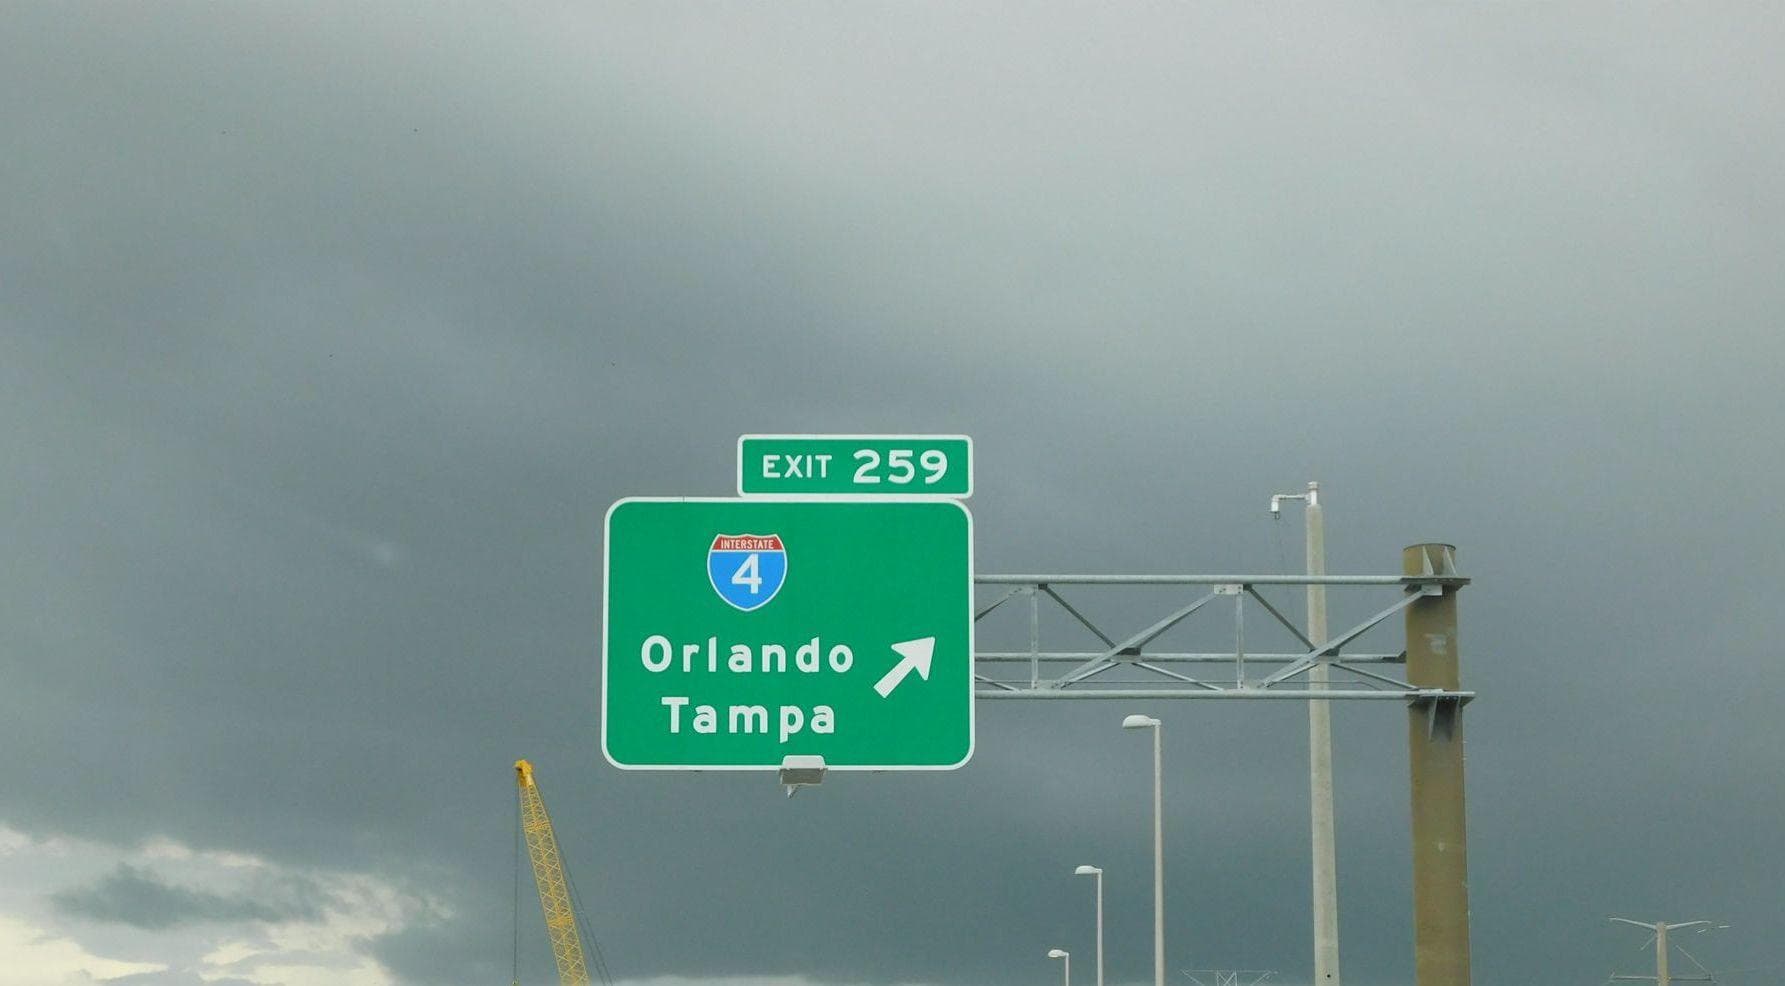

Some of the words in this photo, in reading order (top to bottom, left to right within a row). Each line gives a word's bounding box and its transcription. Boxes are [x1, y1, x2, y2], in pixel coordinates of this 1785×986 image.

[763, 455, 832, 478] EXIT
[853, 449, 948, 484] 259
[720, 539, 774, 549] INTERSTATE
[731, 553, 762, 594] 4
[641, 635, 854, 673] Orlando
[661, 697, 835, 743] Tampa
